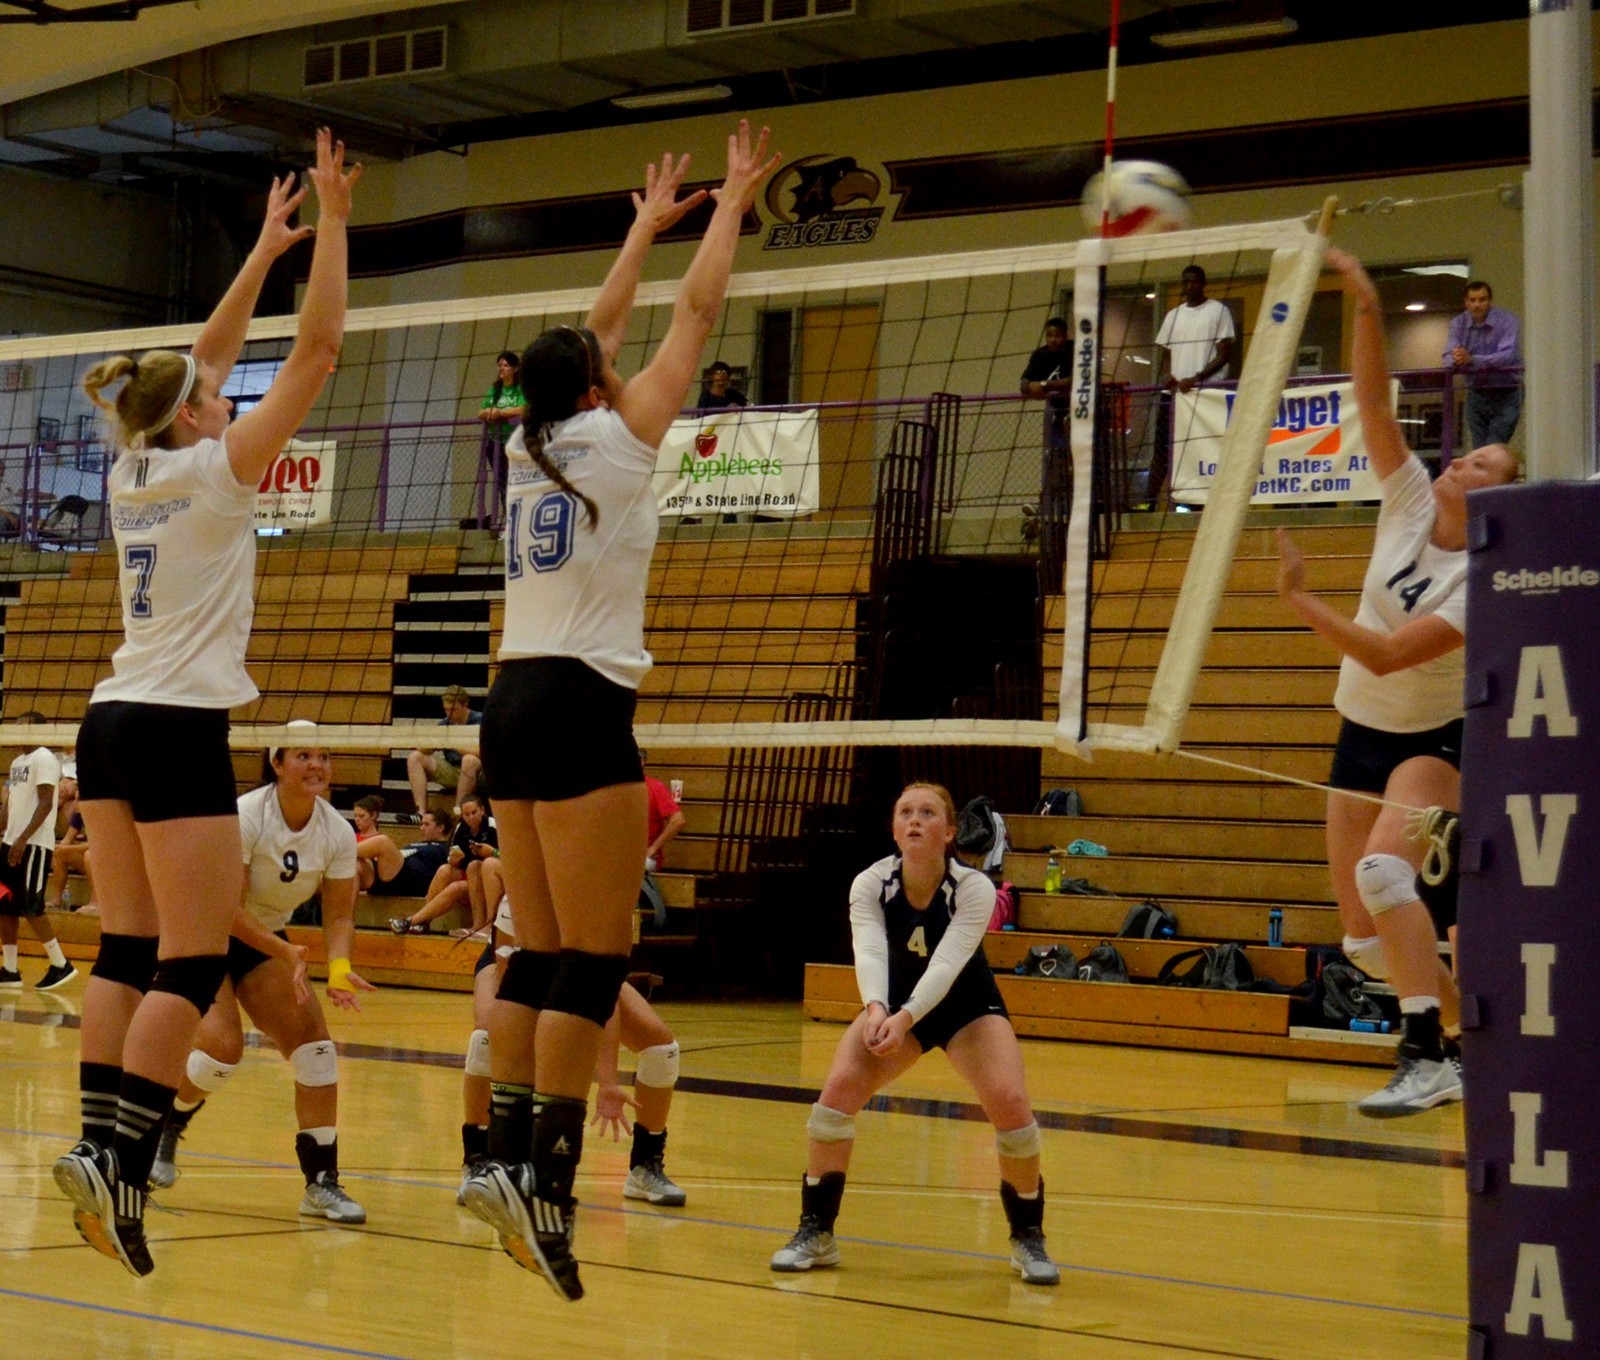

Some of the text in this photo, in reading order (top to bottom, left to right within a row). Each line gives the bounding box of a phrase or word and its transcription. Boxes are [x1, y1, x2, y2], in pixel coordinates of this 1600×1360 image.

[763, 217, 881, 249] EAGLES
[1075, 338, 1092, 419] Schelde
[678, 452, 783, 483] Applebees
[1279, 459, 1332, 474] Rates
[1348, 456, 1368, 471] At
[289, 510, 316, 519] Road
[695, 496, 702, 507] &
[706, 494, 738, 507] State
[740, 493, 761, 506] Line
[763, 492, 796, 506] Road
[507, 490, 577, 580] 19
[125, 544, 157, 618] 7
[1386, 560, 1433, 613] 14
[1492, 565, 1600, 592] Schelde
[280, 850, 299, 883] 9
[907, 926, 927, 957] 4
[1504, 644, 1578, 1342] AVILA
